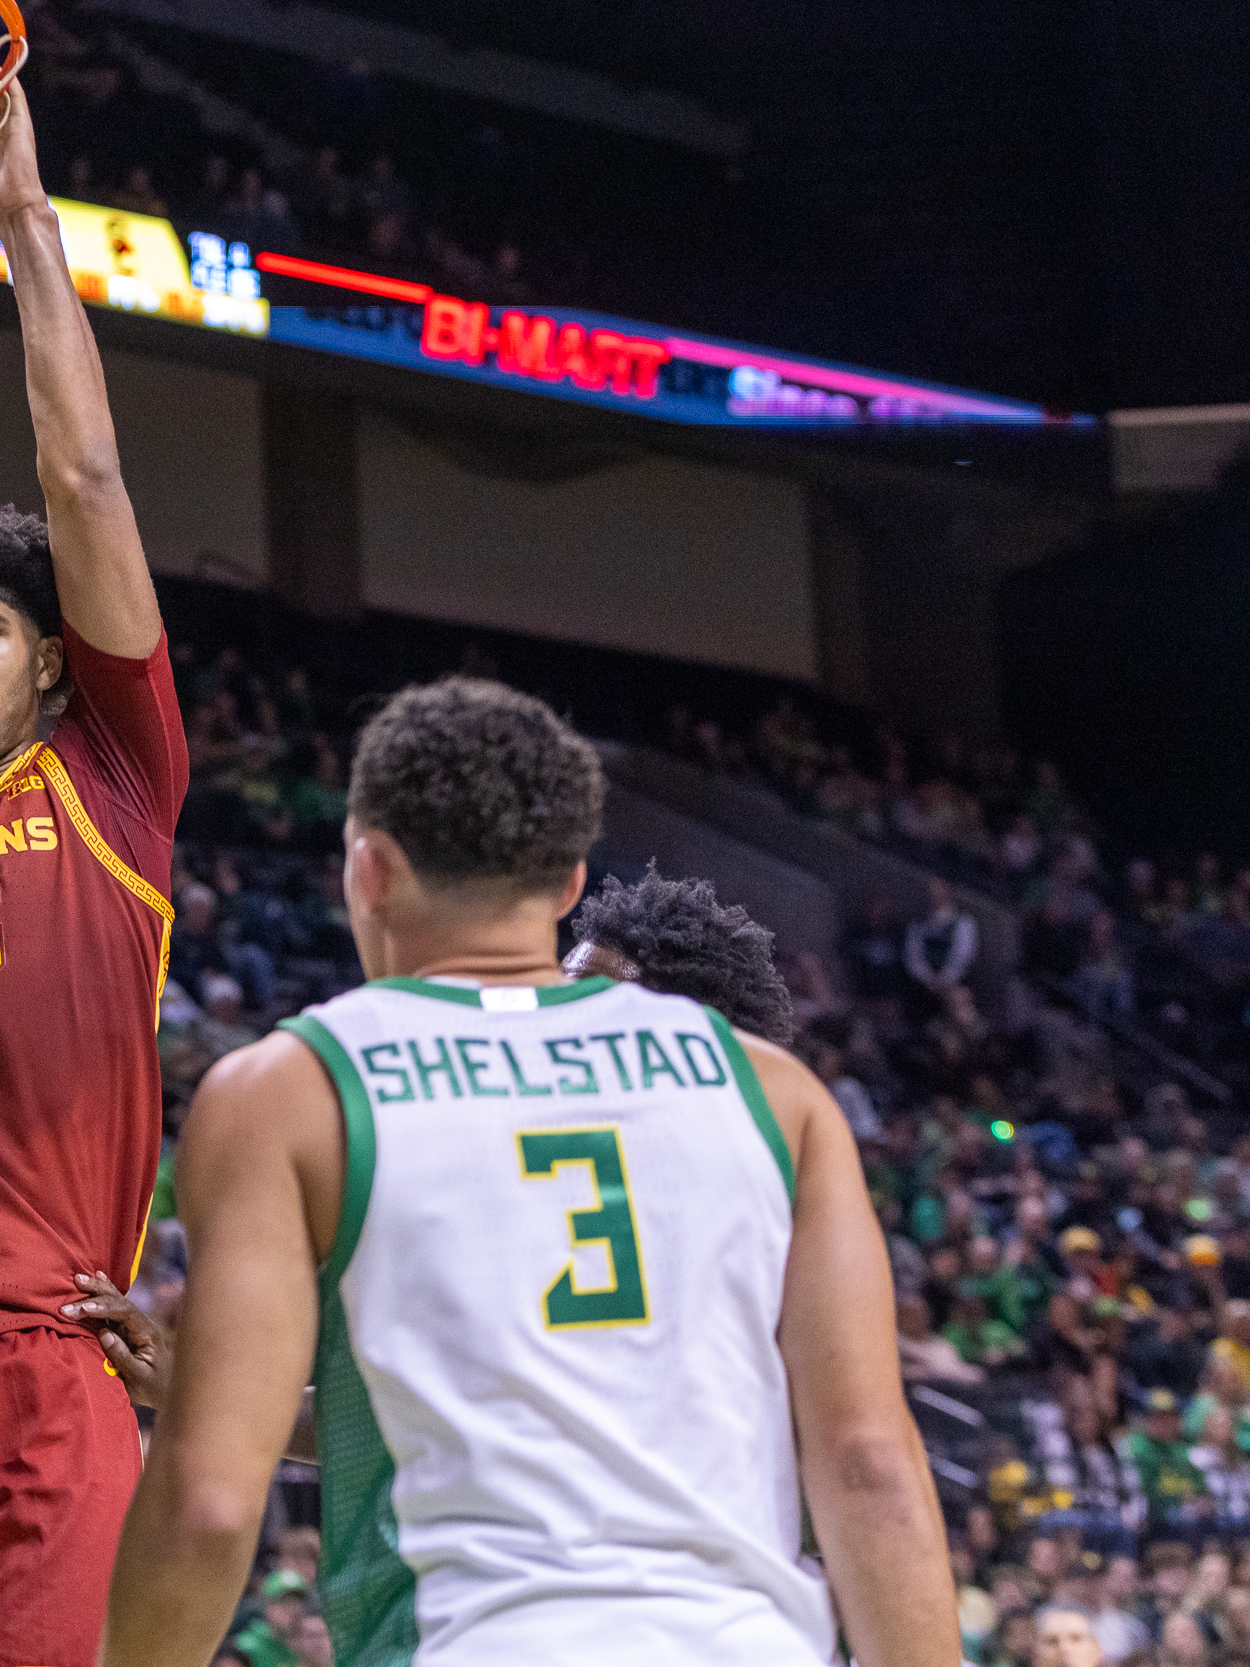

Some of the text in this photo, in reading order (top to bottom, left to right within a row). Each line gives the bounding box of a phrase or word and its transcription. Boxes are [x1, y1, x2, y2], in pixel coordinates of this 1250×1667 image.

[420, 294, 671, 397] BI-MART
[360, 1029, 728, 1104] SHELSTAD
[514, 1121, 651, 1332] 3
